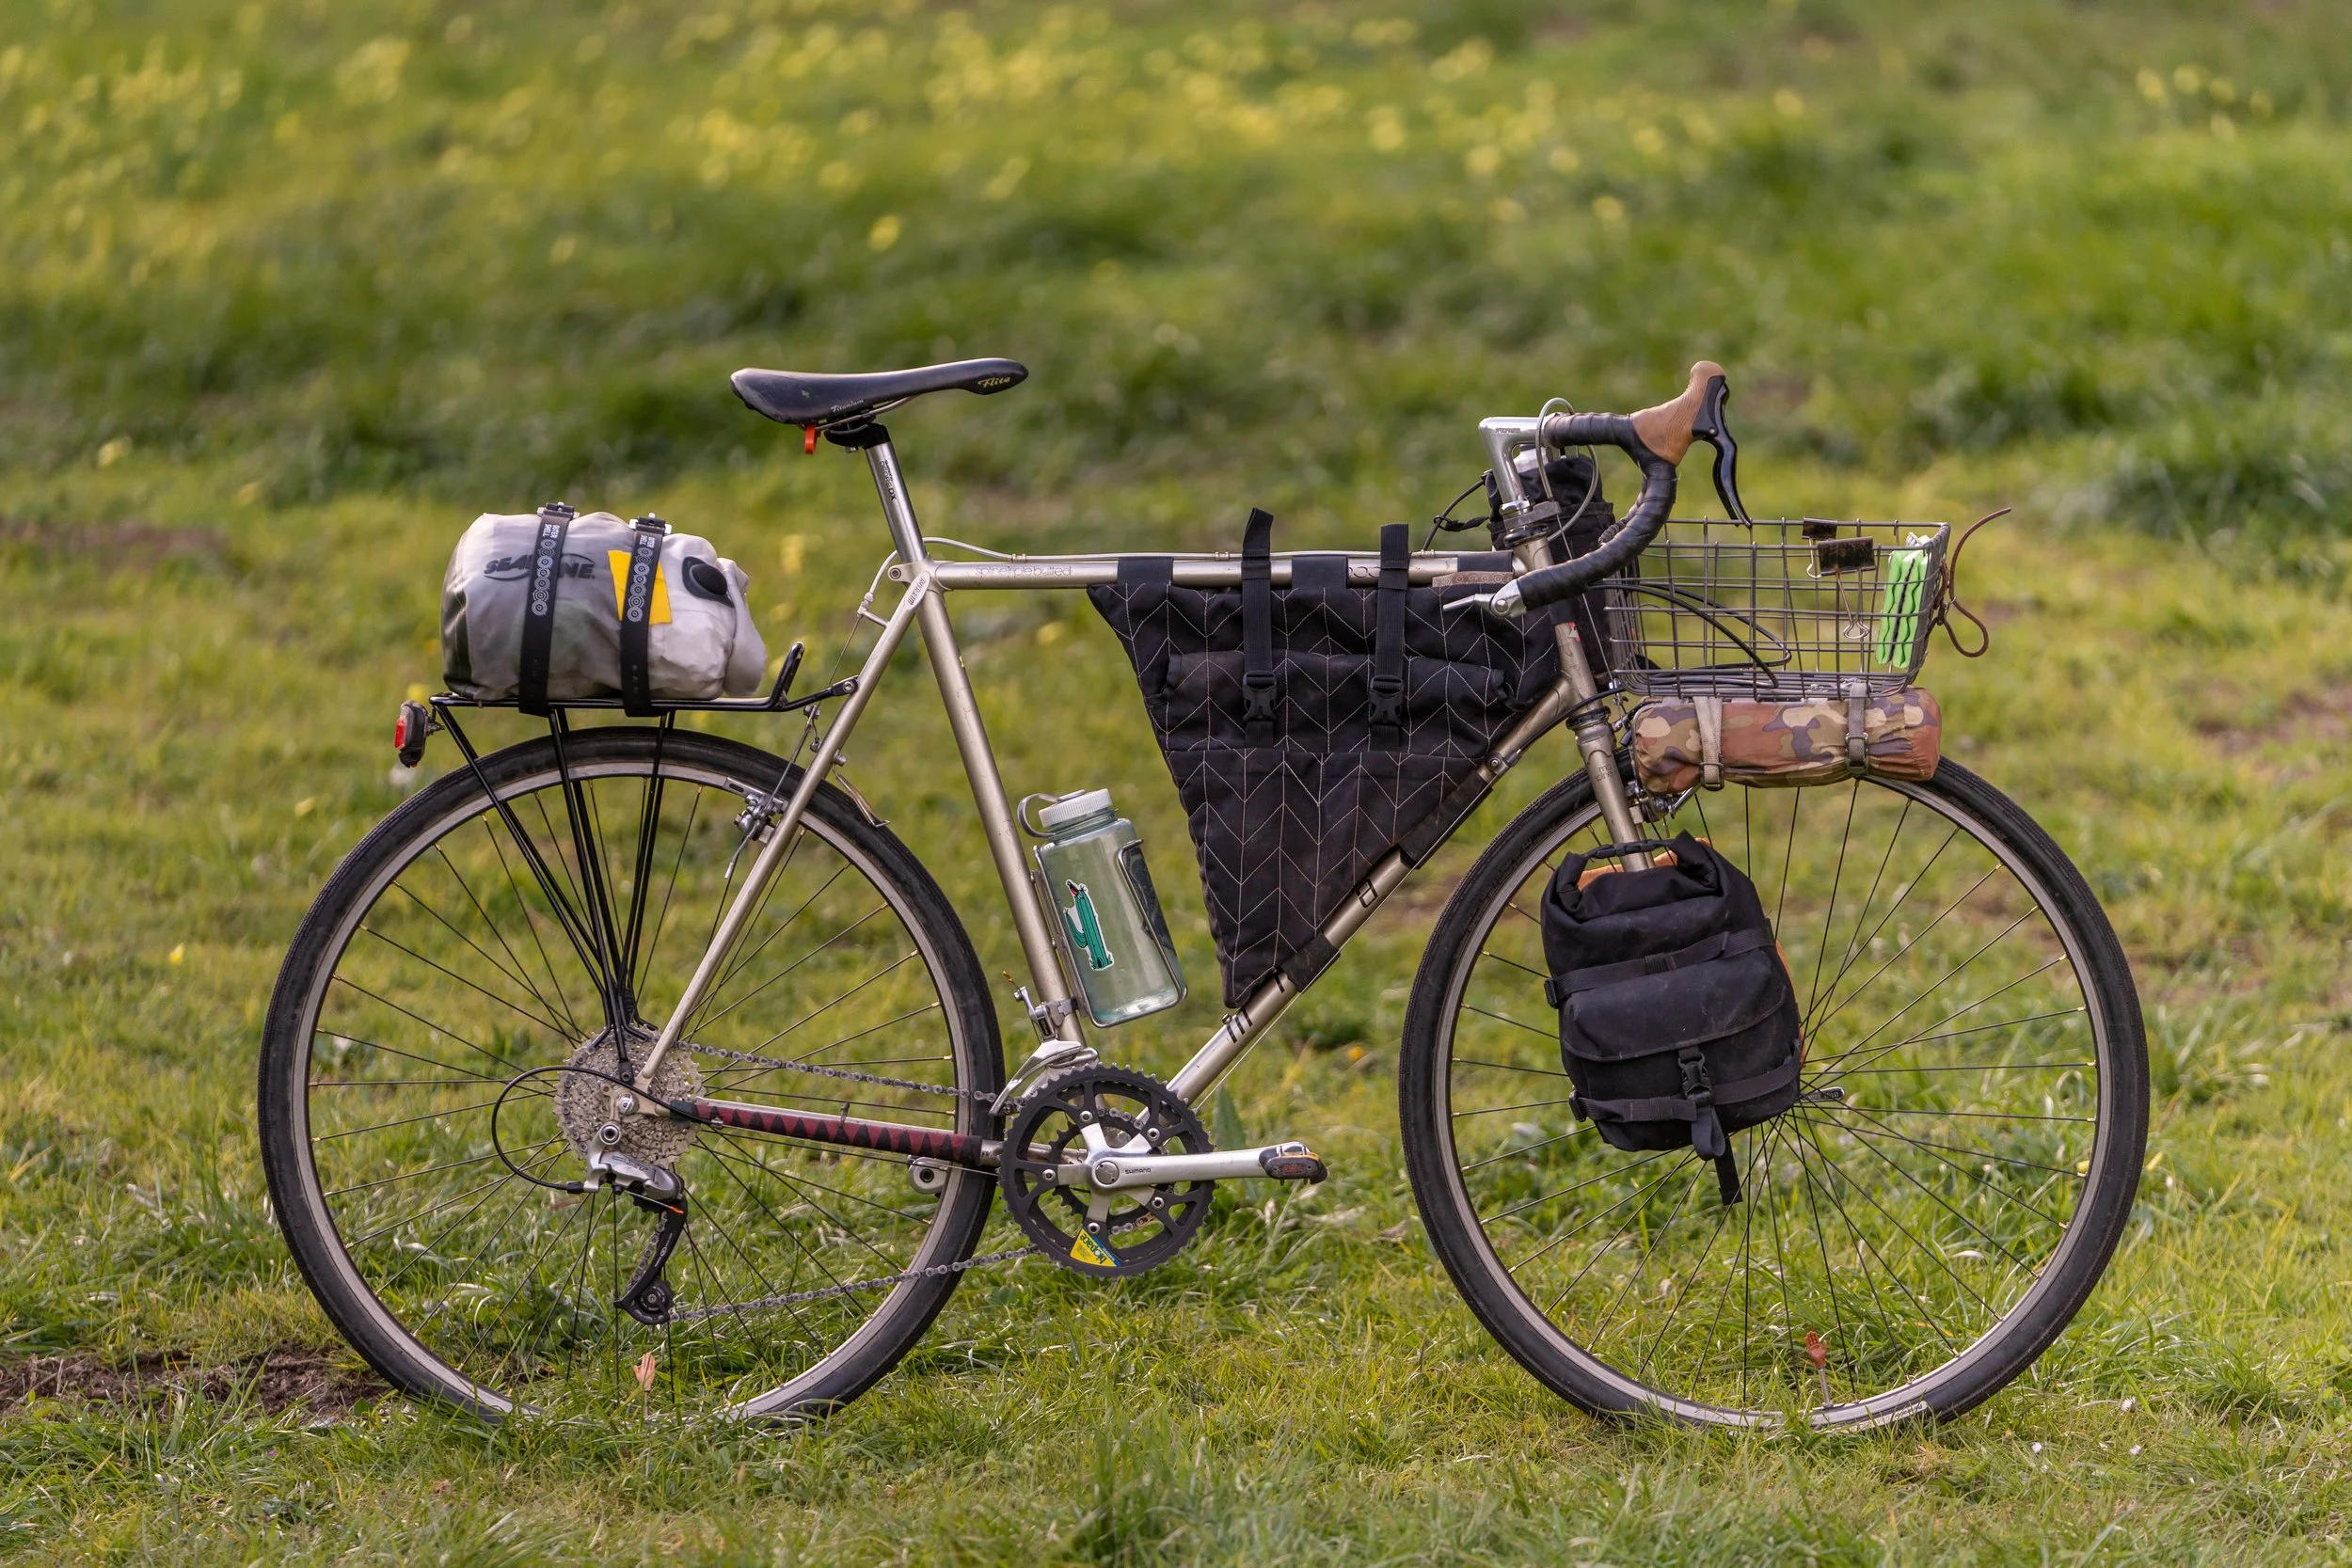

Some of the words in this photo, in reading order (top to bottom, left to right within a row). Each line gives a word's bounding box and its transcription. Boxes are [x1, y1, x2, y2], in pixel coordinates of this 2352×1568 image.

[831, 399, 864, 412] Titanium
[888, 488, 898, 500] DX
[543, 524, 552, 536] SHELL
[550, 524, 560, 538] OUTER
[1079, 1233, 1106, 1264] biopace
